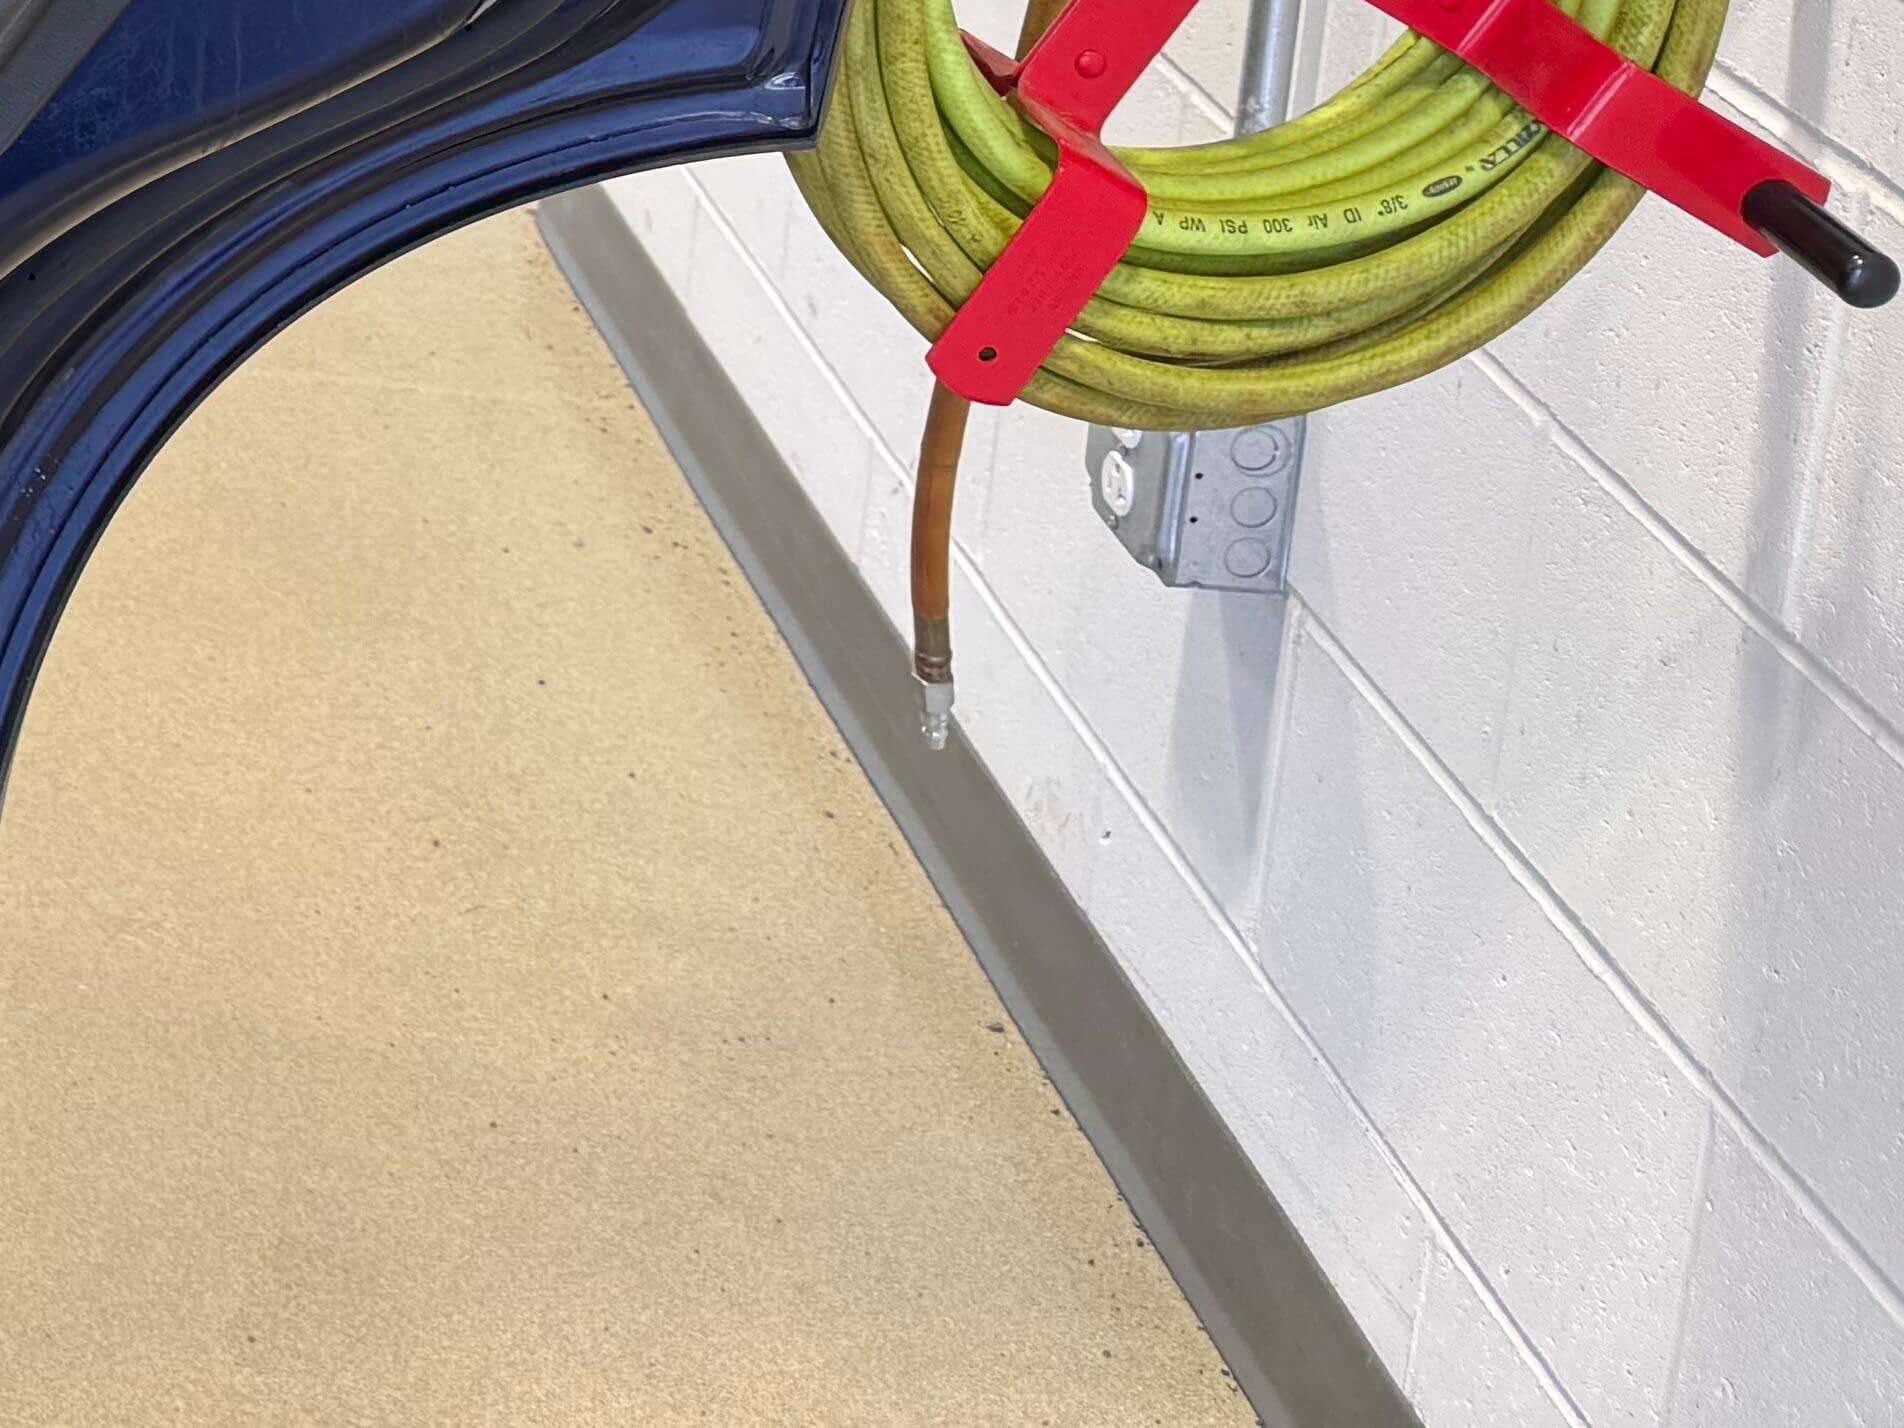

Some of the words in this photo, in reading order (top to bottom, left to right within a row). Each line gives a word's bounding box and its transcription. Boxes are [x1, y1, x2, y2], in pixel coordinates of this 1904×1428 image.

[1152, 210, 1165, 226] A
[1307, 213, 1329, 229] Air
[1343, 207, 1363, 224] ID
[1179, 216, 1206, 233] WP
[1219, 219, 1249, 234] PSI
[1262, 218, 1293, 234] 300
